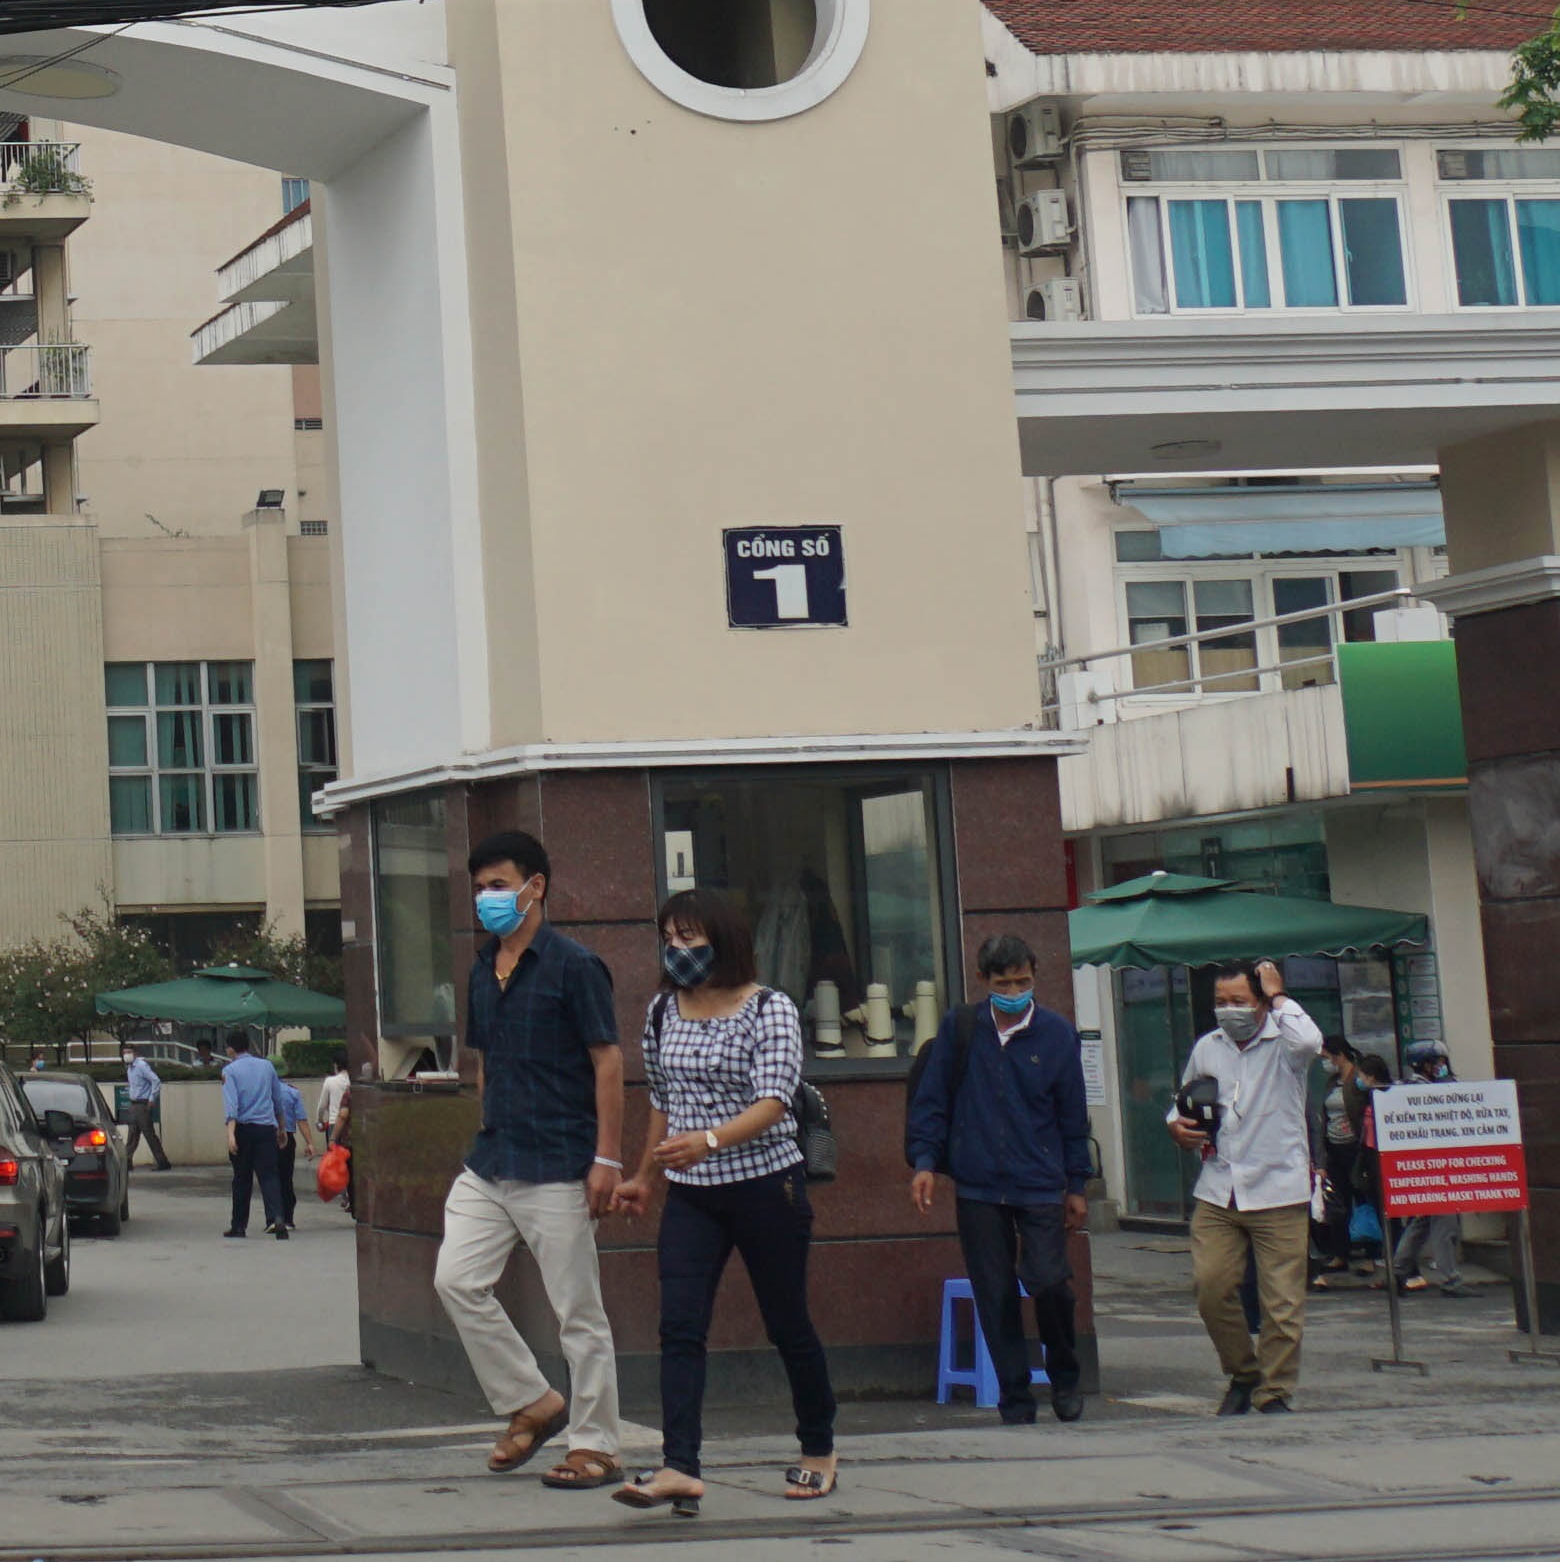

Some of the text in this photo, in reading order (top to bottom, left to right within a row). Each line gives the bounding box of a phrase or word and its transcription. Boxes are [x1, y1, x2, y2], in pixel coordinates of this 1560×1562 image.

[737, 533, 830, 557] CỔNG SỐ
[753, 564, 809, 619] 1
[1406, 1096, 1421, 1106] VUI
[1417, 1112, 1432, 1121] TRA
[1396, 1155, 1506, 1171] PLEASE STOP FOR CHECKING
[1449, 1173, 1488, 1185] WASHING
[1489, 1172, 1518, 1182] HANDS
[1390, 1195, 1407, 1205] AND
[1408, 1192, 1447, 1204] WEARING
[1474, 1189, 1501, 1200] THANK
